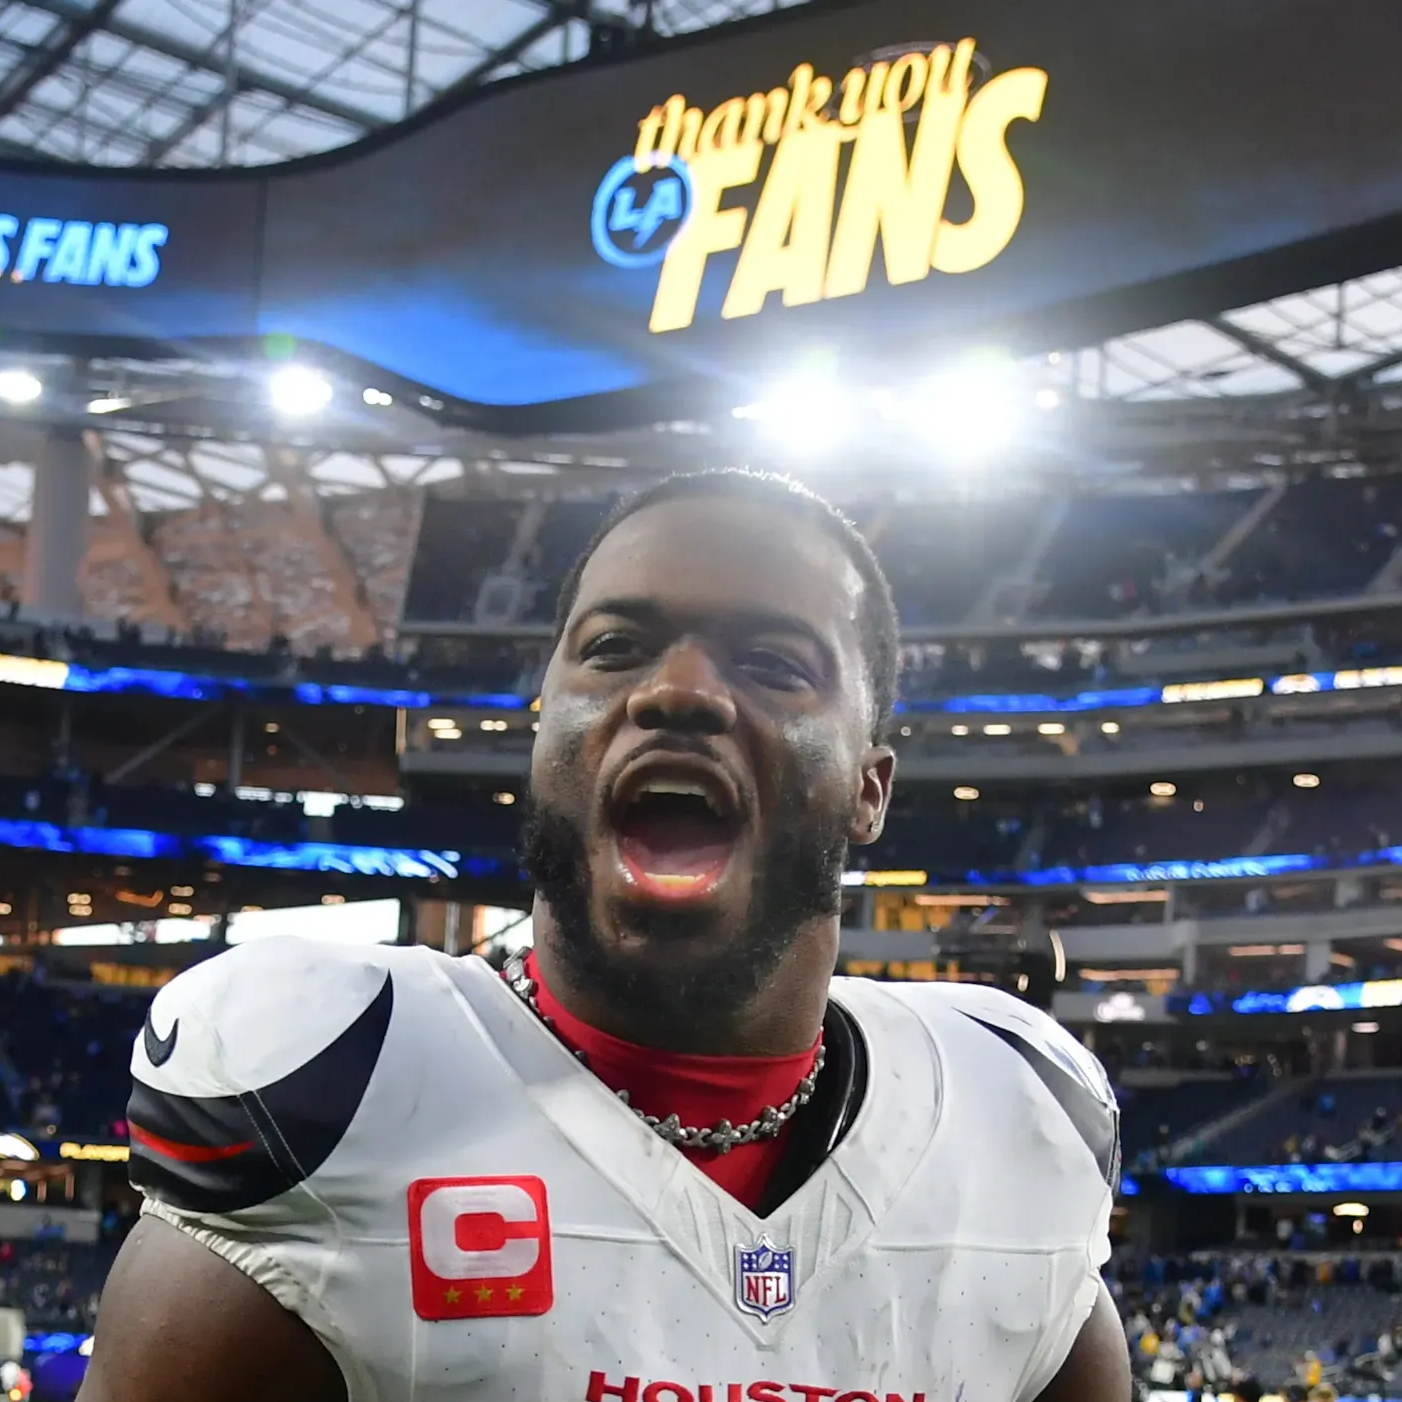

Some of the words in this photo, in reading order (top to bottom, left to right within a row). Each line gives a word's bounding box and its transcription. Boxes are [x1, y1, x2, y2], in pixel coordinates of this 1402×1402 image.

[635, 63, 831, 172] thank
[834, 37, 976, 141] you
[649, 67, 1048, 333] FANS
[14, 217, 168, 288] FANS
[420, 1184, 540, 1280] C
[744, 1274, 788, 1307] NFL
